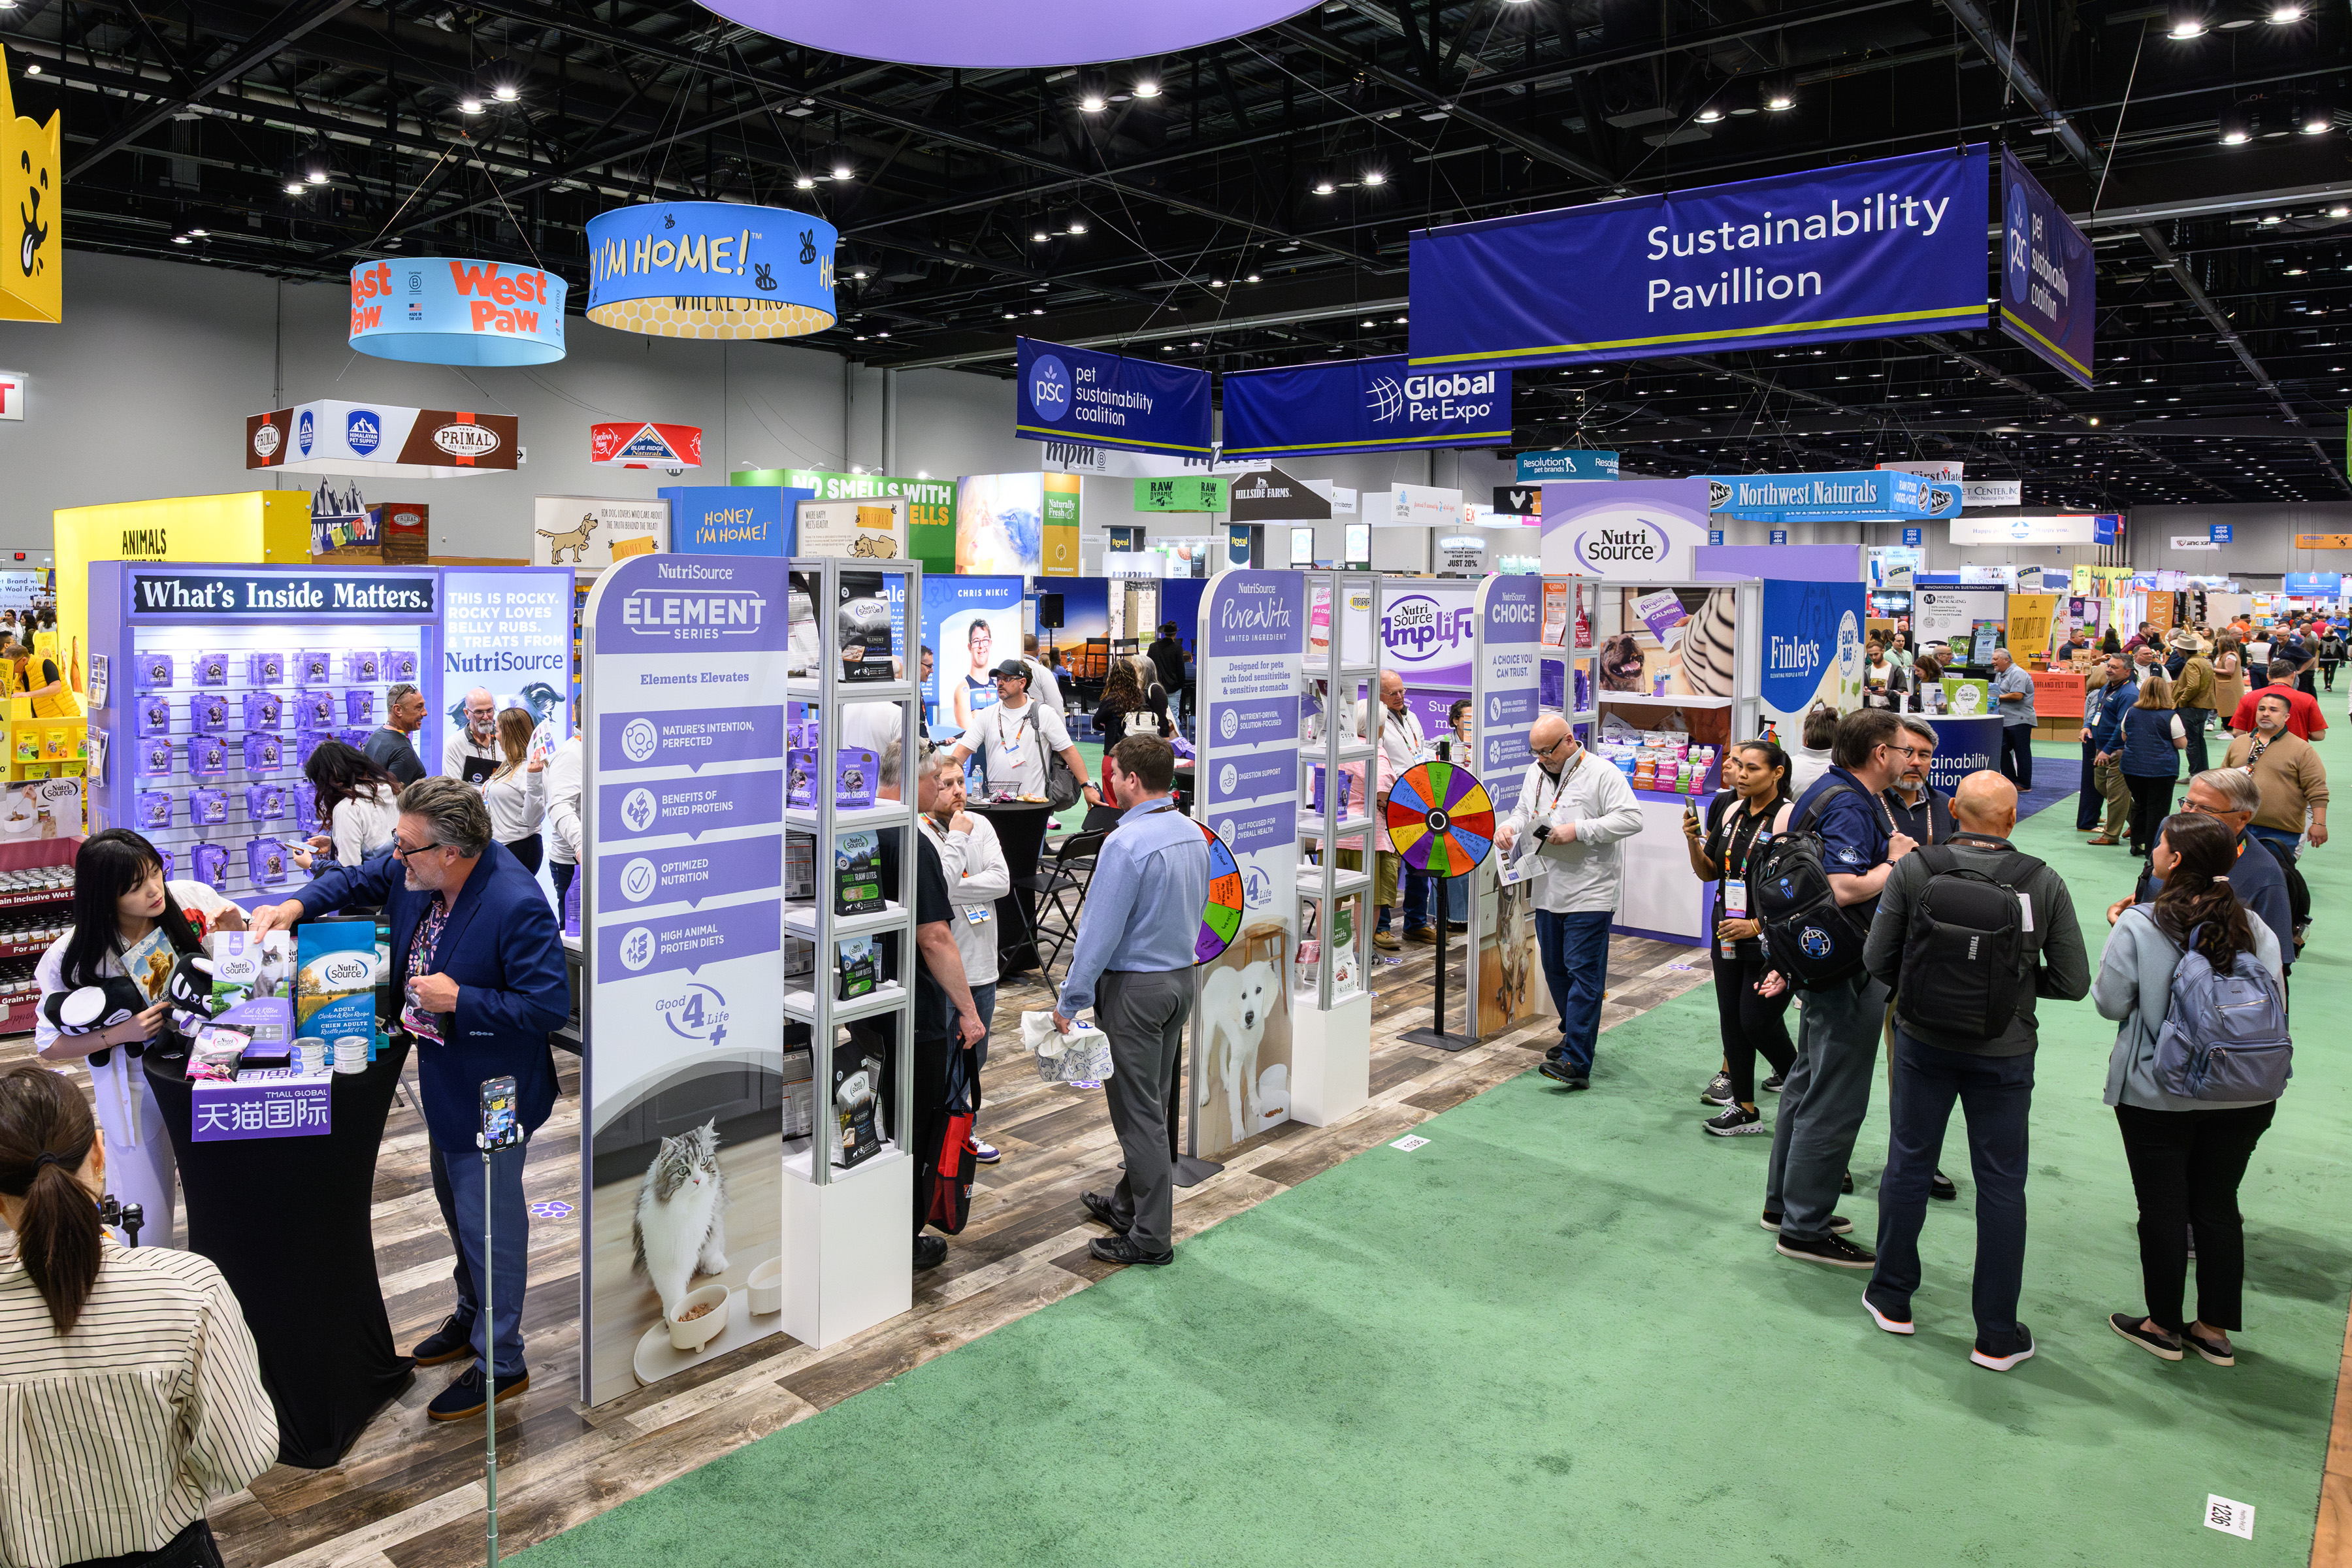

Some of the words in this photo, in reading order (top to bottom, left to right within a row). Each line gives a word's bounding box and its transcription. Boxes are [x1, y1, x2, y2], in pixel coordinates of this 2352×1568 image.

[1646, 193, 1950, 261] Sustainability
[633, 229, 751, 276] HOME!
[449, 261, 547, 306] West
[1648, 267, 1821, 313] Pavillion
[2031, 282, 2057, 322] coalition
[470, 301, 539, 334] Paw
[1076, 367, 1096, 384] pet
[1404, 371, 1495, 400] Global
[1075, 387, 1153, 415] sustainability
[1075, 405, 1125, 426] coalition
[1410, 402, 1439, 422] Pet
[1441, 399, 1490, 424] Expo
[257, 432, 276, 447] PRIMAL
[441, 431, 491, 446] PRIMAL
[1523, 457, 1564, 468] Resolution
[827, 478, 899, 498] SMELLS
[903, 483, 951, 505] WITH
[1151, 482, 1173, 491] RAW
[1201, 482, 1217, 492] RAW
[1899, 480, 1907, 490] RAW
[1907, 482, 1917, 491] FOOD
[1151, 491, 1173, 500] DYNAMIC
[1200, 491, 1217, 500] DYNAMIC
[1235, 488, 1266, 499] HILLSIDE
[1267, 488, 1290, 498] FARMS
[1738, 482, 1811, 507] Northwest
[1813, 480, 1877, 507] Naturals
[1048, 498, 1075, 510] Naturally
[617, 510, 631, 518] LOVERS
[631, 510, 640, 519] WHO
[640, 510, 649, 519] CARE
[704, 508, 754, 526] HONEY
[862, 513, 889, 526] BUFFALO
[1049, 508, 1065, 517] Fresh
[696, 527, 717, 544] I'M
[719, 522, 767, 542] HOME!
[1601, 529, 1646, 545] Nutri
[122, 528, 167, 555] ANIMALS
[1112, 538, 1129, 548] Reveal
[1231, 536, 1248, 547] Reveal
[1588, 542, 1654, 561] Source
[657, 563, 732, 581] NutriSource
[142, 580, 235, 608] What's
[246, 581, 324, 608] Inside
[332, 583, 429, 609] Matters.
[1238, 583, 1276, 594] NutriSource
[448, 593, 482, 604] THIS
[488, 593, 501, 604] IS
[506, 593, 559, 604] ROCKY.
[1502, 593, 1526, 601] NutriSource
[448, 607, 501, 619] ROCKY
[506, 607, 552, 619] LOVES
[623, 598, 767, 625] ELEMENT
[1401, 603, 1428, 616] Nutri
[1492, 604, 1535, 623] CHOICE
[1651, 607, 1681, 621] CALMING
[448, 622, 494, 633] BELLY
[499, 621, 542, 633] RUBS.
[1394, 613, 1433, 627] Source
[448, 636, 458, 647] &
[463, 635, 519, 648] TREATS
[524, 634, 564, 647] FROM
[674, 629, 719, 640] SERIES
[1842, 630, 1854, 645] EACH
[1492, 656, 1497, 666] A
[1497, 654, 1520, 665] CHOICE
[1520, 653, 1533, 663] YOU
[1770, 635, 1820, 677] Finley's
[1842, 646, 1852, 662] BAG
[445, 651, 564, 673] NutriSource
[1229, 662, 1260, 673] Designed
[1260, 662, 1269, 670] for
[1271, 661, 1284, 671] pets
[640, 672, 698, 685] Elements
[700, 670, 750, 684] Elevates
[1221, 674, 1237, 684] with
[1238, 674, 1252, 683] food
[1254, 672, 1291, 682] sensitivities
[1496, 668, 1509, 678] CAN
[1509, 667, 1528, 677] TRUST.
[1230, 685, 1258, 694] sensitive
[1259, 683, 1289, 693] stomachs
[662, 723, 705, 736] NATURE'S
[707, 721, 755, 735] INTENTION,
[1239, 719, 1282, 730] SOLUTION-FOCUSED
[662, 736, 712, 749] PERFECTED
[1239, 770, 1262, 780] DIGESTION
[1262, 768, 1281, 777] SUPPORT
[662, 792, 703, 805] BENEFITS
[706, 791, 717, 803] OF
[662, 805, 690, 818] MIXED
[692, 801, 734, 816] PROTEINS
[1247, 819, 1267, 830] FOCUSED
[1267, 817, 1276, 826] FOR
[1237, 829, 1256, 840] OVERALL
[1257, 826, 1273, 836] HEALTH
[661, 858, 709, 874] OPTIMIZED
[661, 871, 709, 887] NUTRITION
[14, 893, 50, 904] Inclusive
[52, 890, 69, 899] Wet
[661, 930, 683, 943] HIGH
[685, 924, 718, 939] ANIMAL
[660, 939, 697, 955] PROTEIN
[699, 936, 725, 951] DIETS
[1968, 936, 1980, 960] THULE
[225, 966, 250, 975] Source
[331, 970, 362, 979] Source
[337, 964, 358, 972] Nutri
[2, 996, 24, 1004] Grain
[655, 996, 686, 1012] Good
[682, 994, 704, 1029] 4
[707, 1011, 730, 1026] Life
[265, 1090, 293, 1099] TMALL
[294, 1089, 327, 1098] GLOBAL
[197, 1098, 327, 1132] 天猫国际
[2211, 1502, 2232, 1527] 1236
